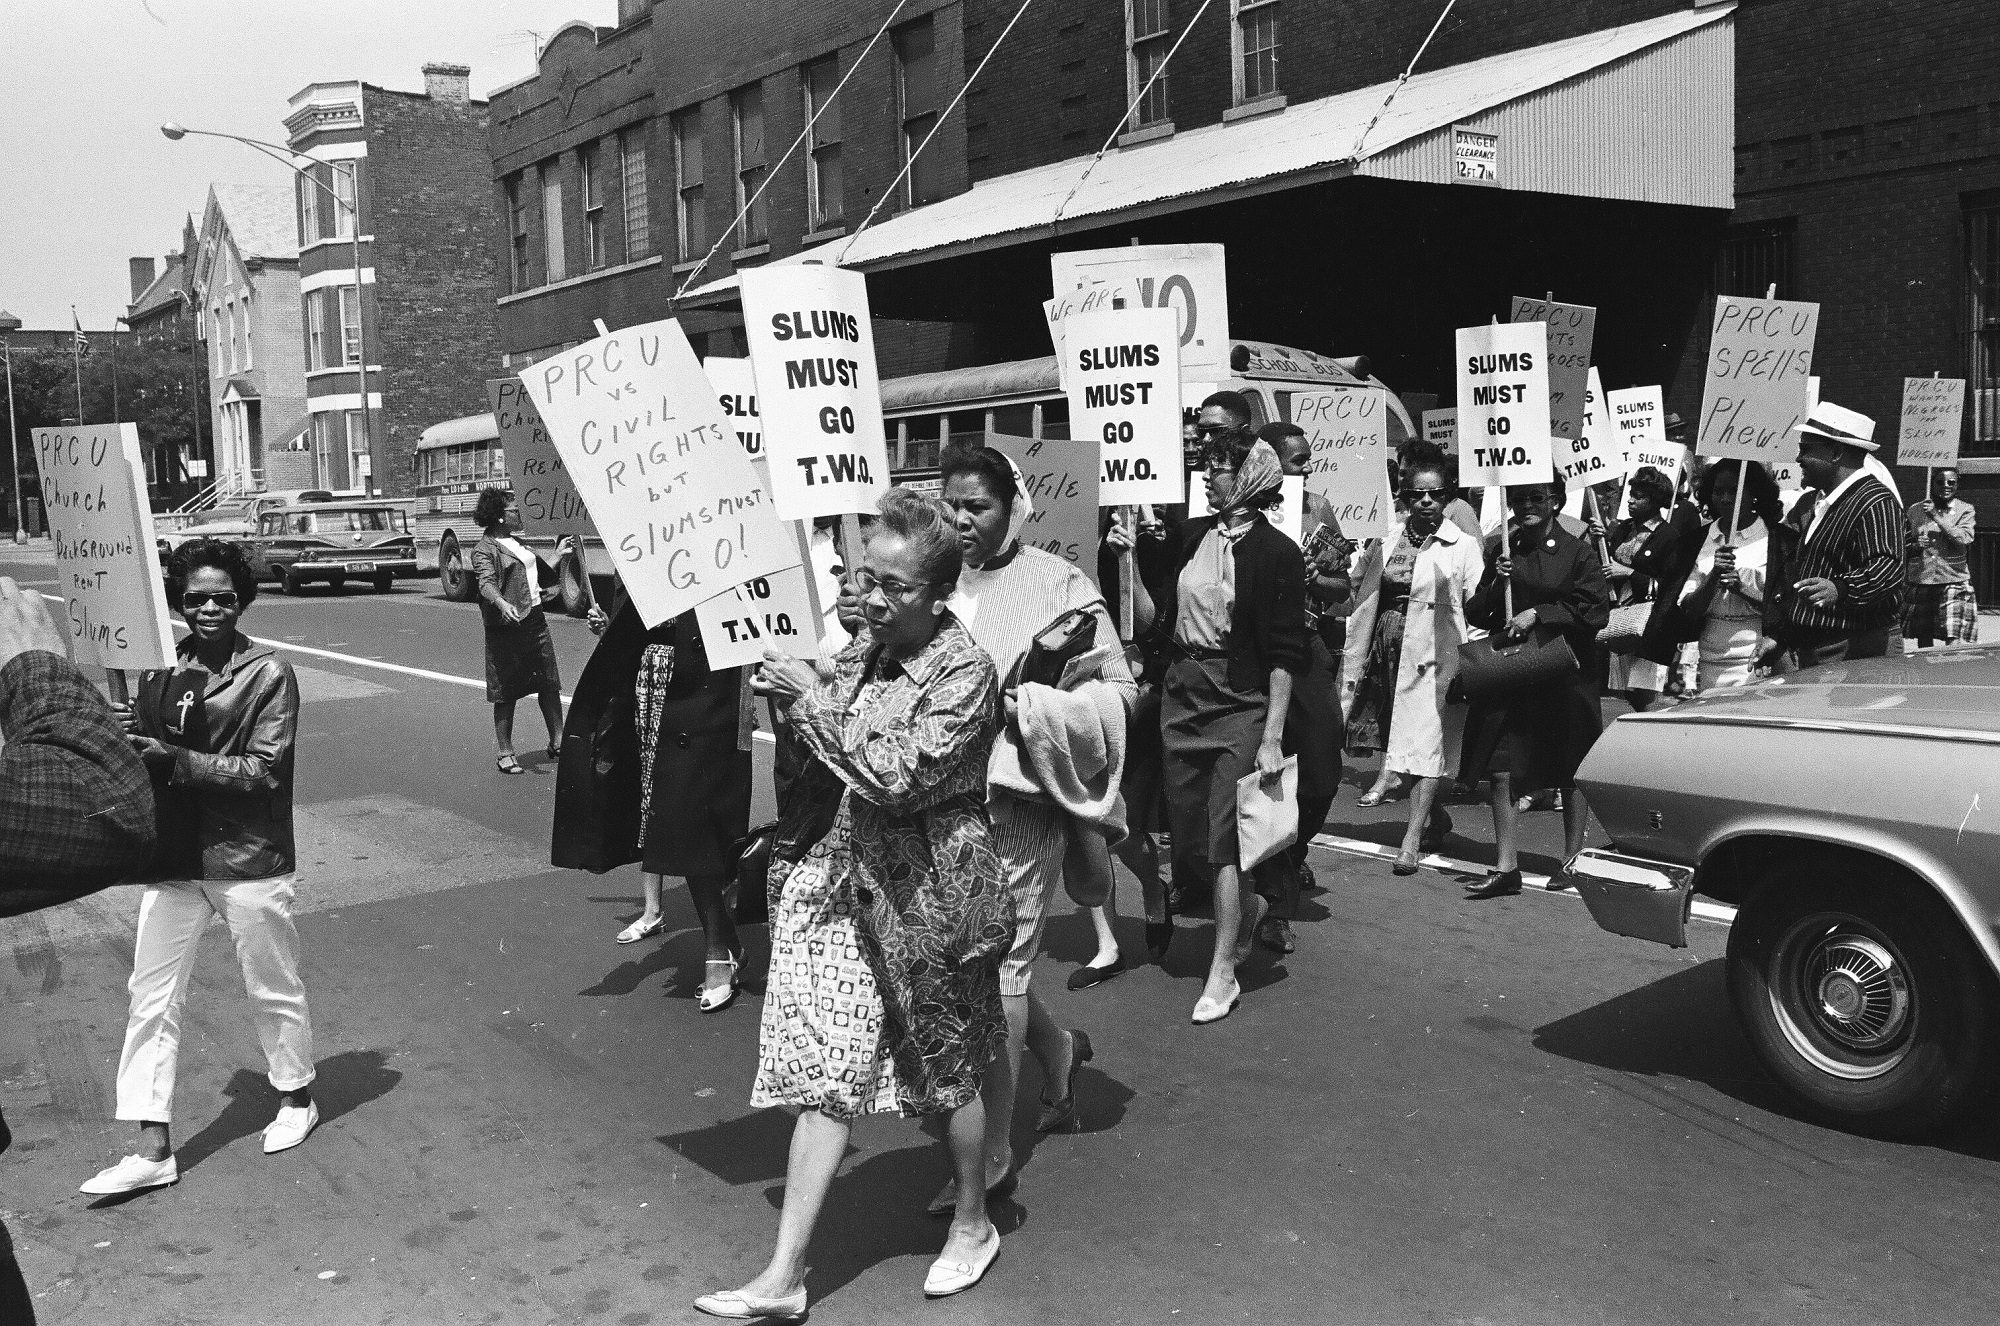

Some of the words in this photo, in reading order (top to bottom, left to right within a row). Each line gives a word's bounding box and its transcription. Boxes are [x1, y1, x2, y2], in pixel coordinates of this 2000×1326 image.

[1456, 133, 1496, 148] DANGER
[1456, 147, 1495, 160] CLEARANCE
[1514, 301, 1584, 328] PRCU
[1715, 304, 1810, 338] PRCU
[771, 310, 860, 343] SLUMS
[1079, 344, 1160, 371] SLUMS
[1250, 358, 1308, 373] SCHOOL
[1311, 362, 1343, 377] BUS
[1468, 352, 1533, 375] SLUMS
[544, 335, 660, 404] PRCU
[785, 357, 859, 390] MUST
[718, 394, 760, 418] SLU
[1085, 382, 1153, 409] MUST
[1473, 384, 1527, 406] MUST
[818, 405, 855, 434] GO
[1296, 395, 1377, 422] PRCU
[1616, 401, 1655, 415] SLUMS
[1102, 421, 1134, 445] GO
[1428, 418, 1456, 429] SLUMS
[1487, 416, 1511, 436] GO
[1620, 417, 1652, 431] MUST
[1701, 396, 1800, 449] Phew!
[1306, 429, 1378, 452] landers
[1430, 430, 1454, 440] MUST
[1571, 437, 1590, 453] GO
[41, 433, 107, 469] PRCU
[605, 423, 724, 494] RIGHTS
[1025, 441, 1043, 458] A
[1474, 446, 1532, 468] T.W.O.
[1637, 453, 1676, 468] SLUMS
[796, 453, 874, 487] T.W.O.
[1564, 456, 1606, 479] T.W.O.
